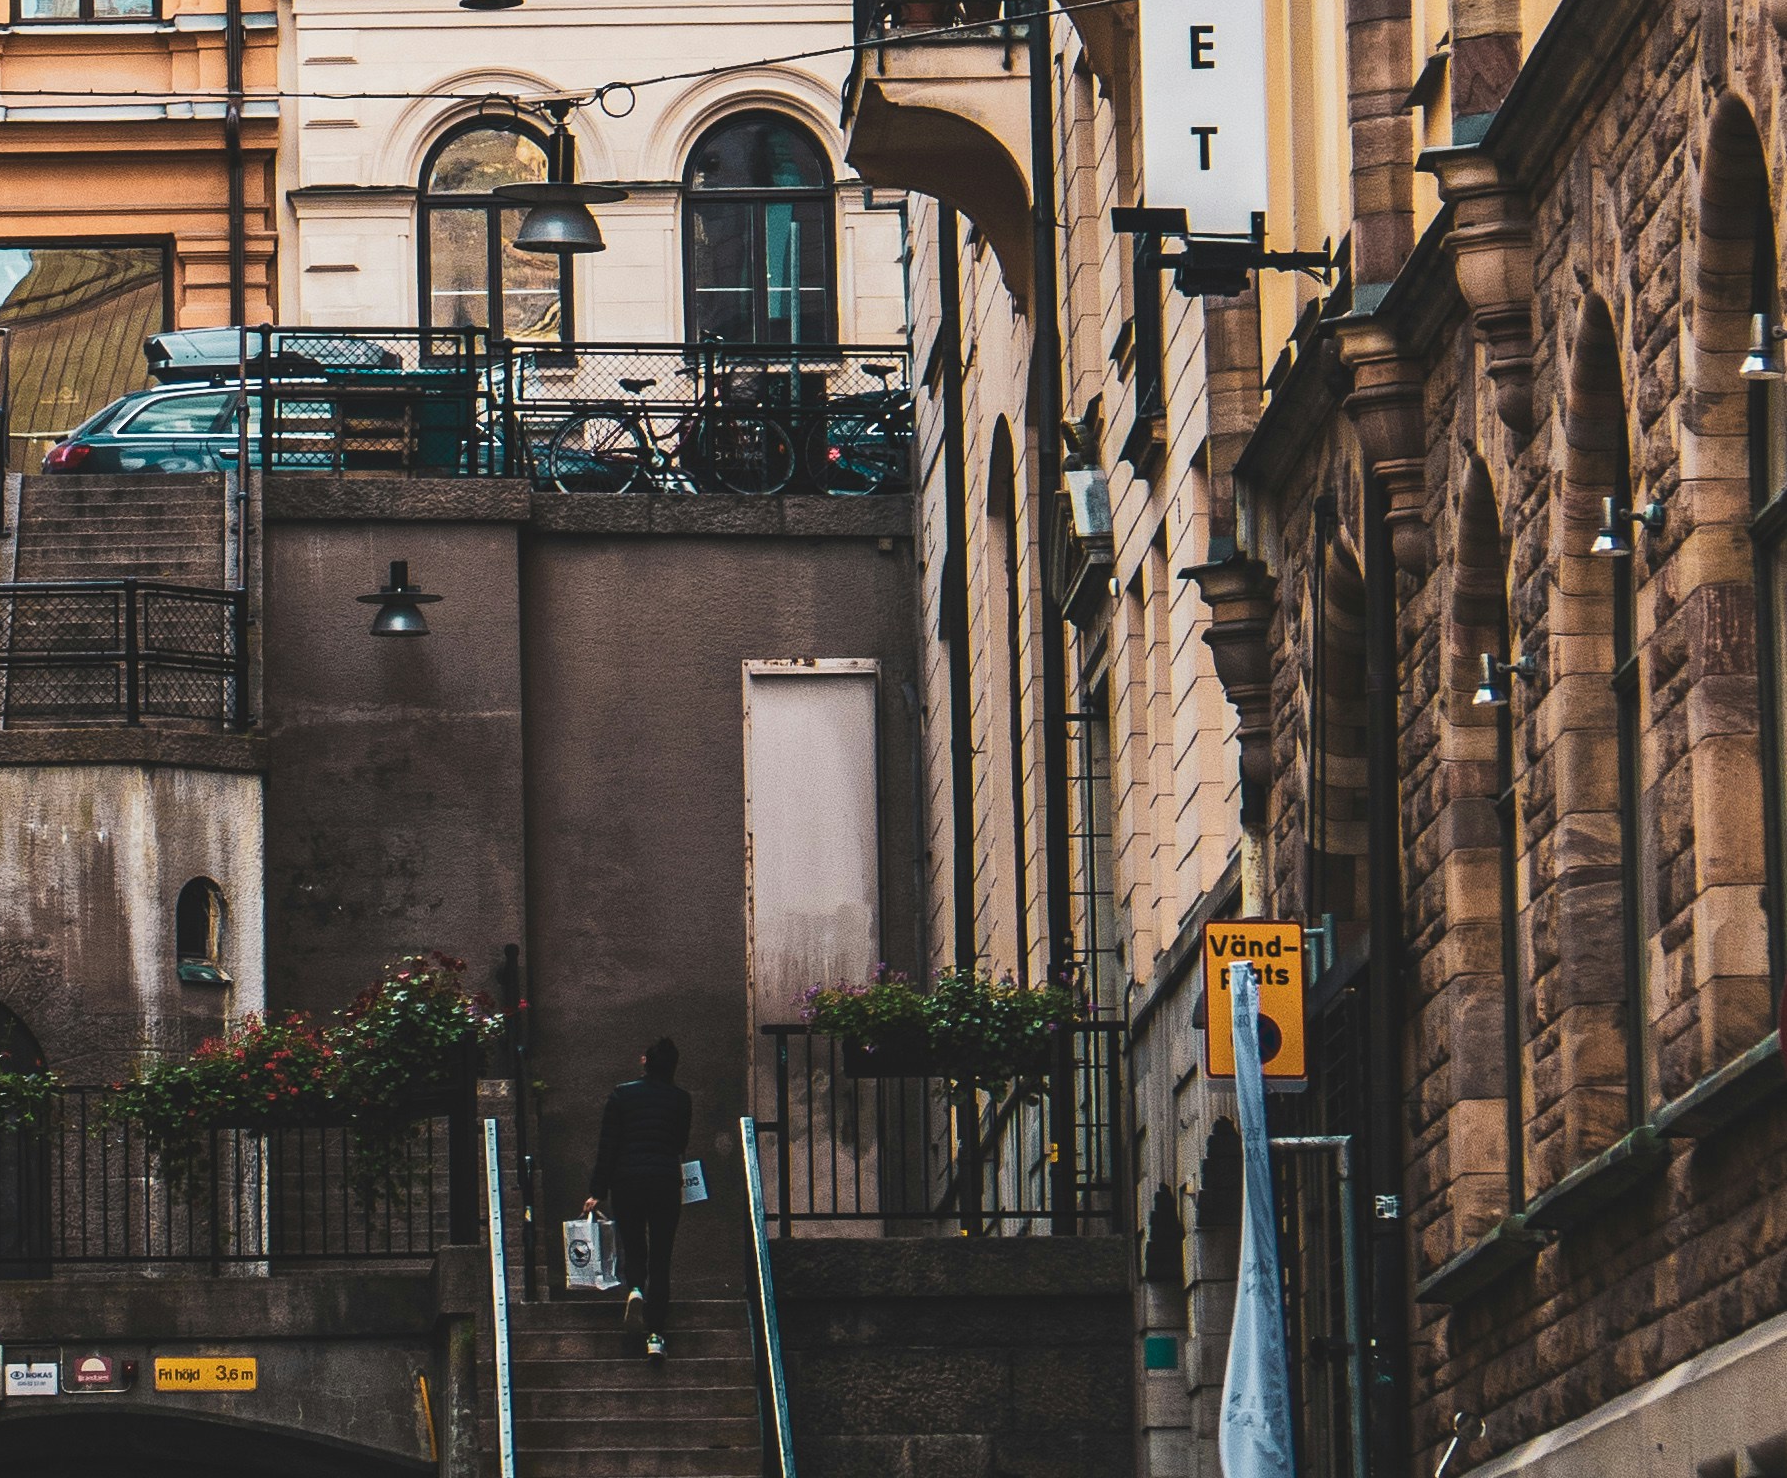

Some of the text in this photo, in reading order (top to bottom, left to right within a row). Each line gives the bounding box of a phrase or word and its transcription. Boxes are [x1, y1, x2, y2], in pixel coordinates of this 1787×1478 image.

[1209, 934, 1299, 957] Vänd-
[158, 1365, 254, 1383] Fri höjd 3,6 m
